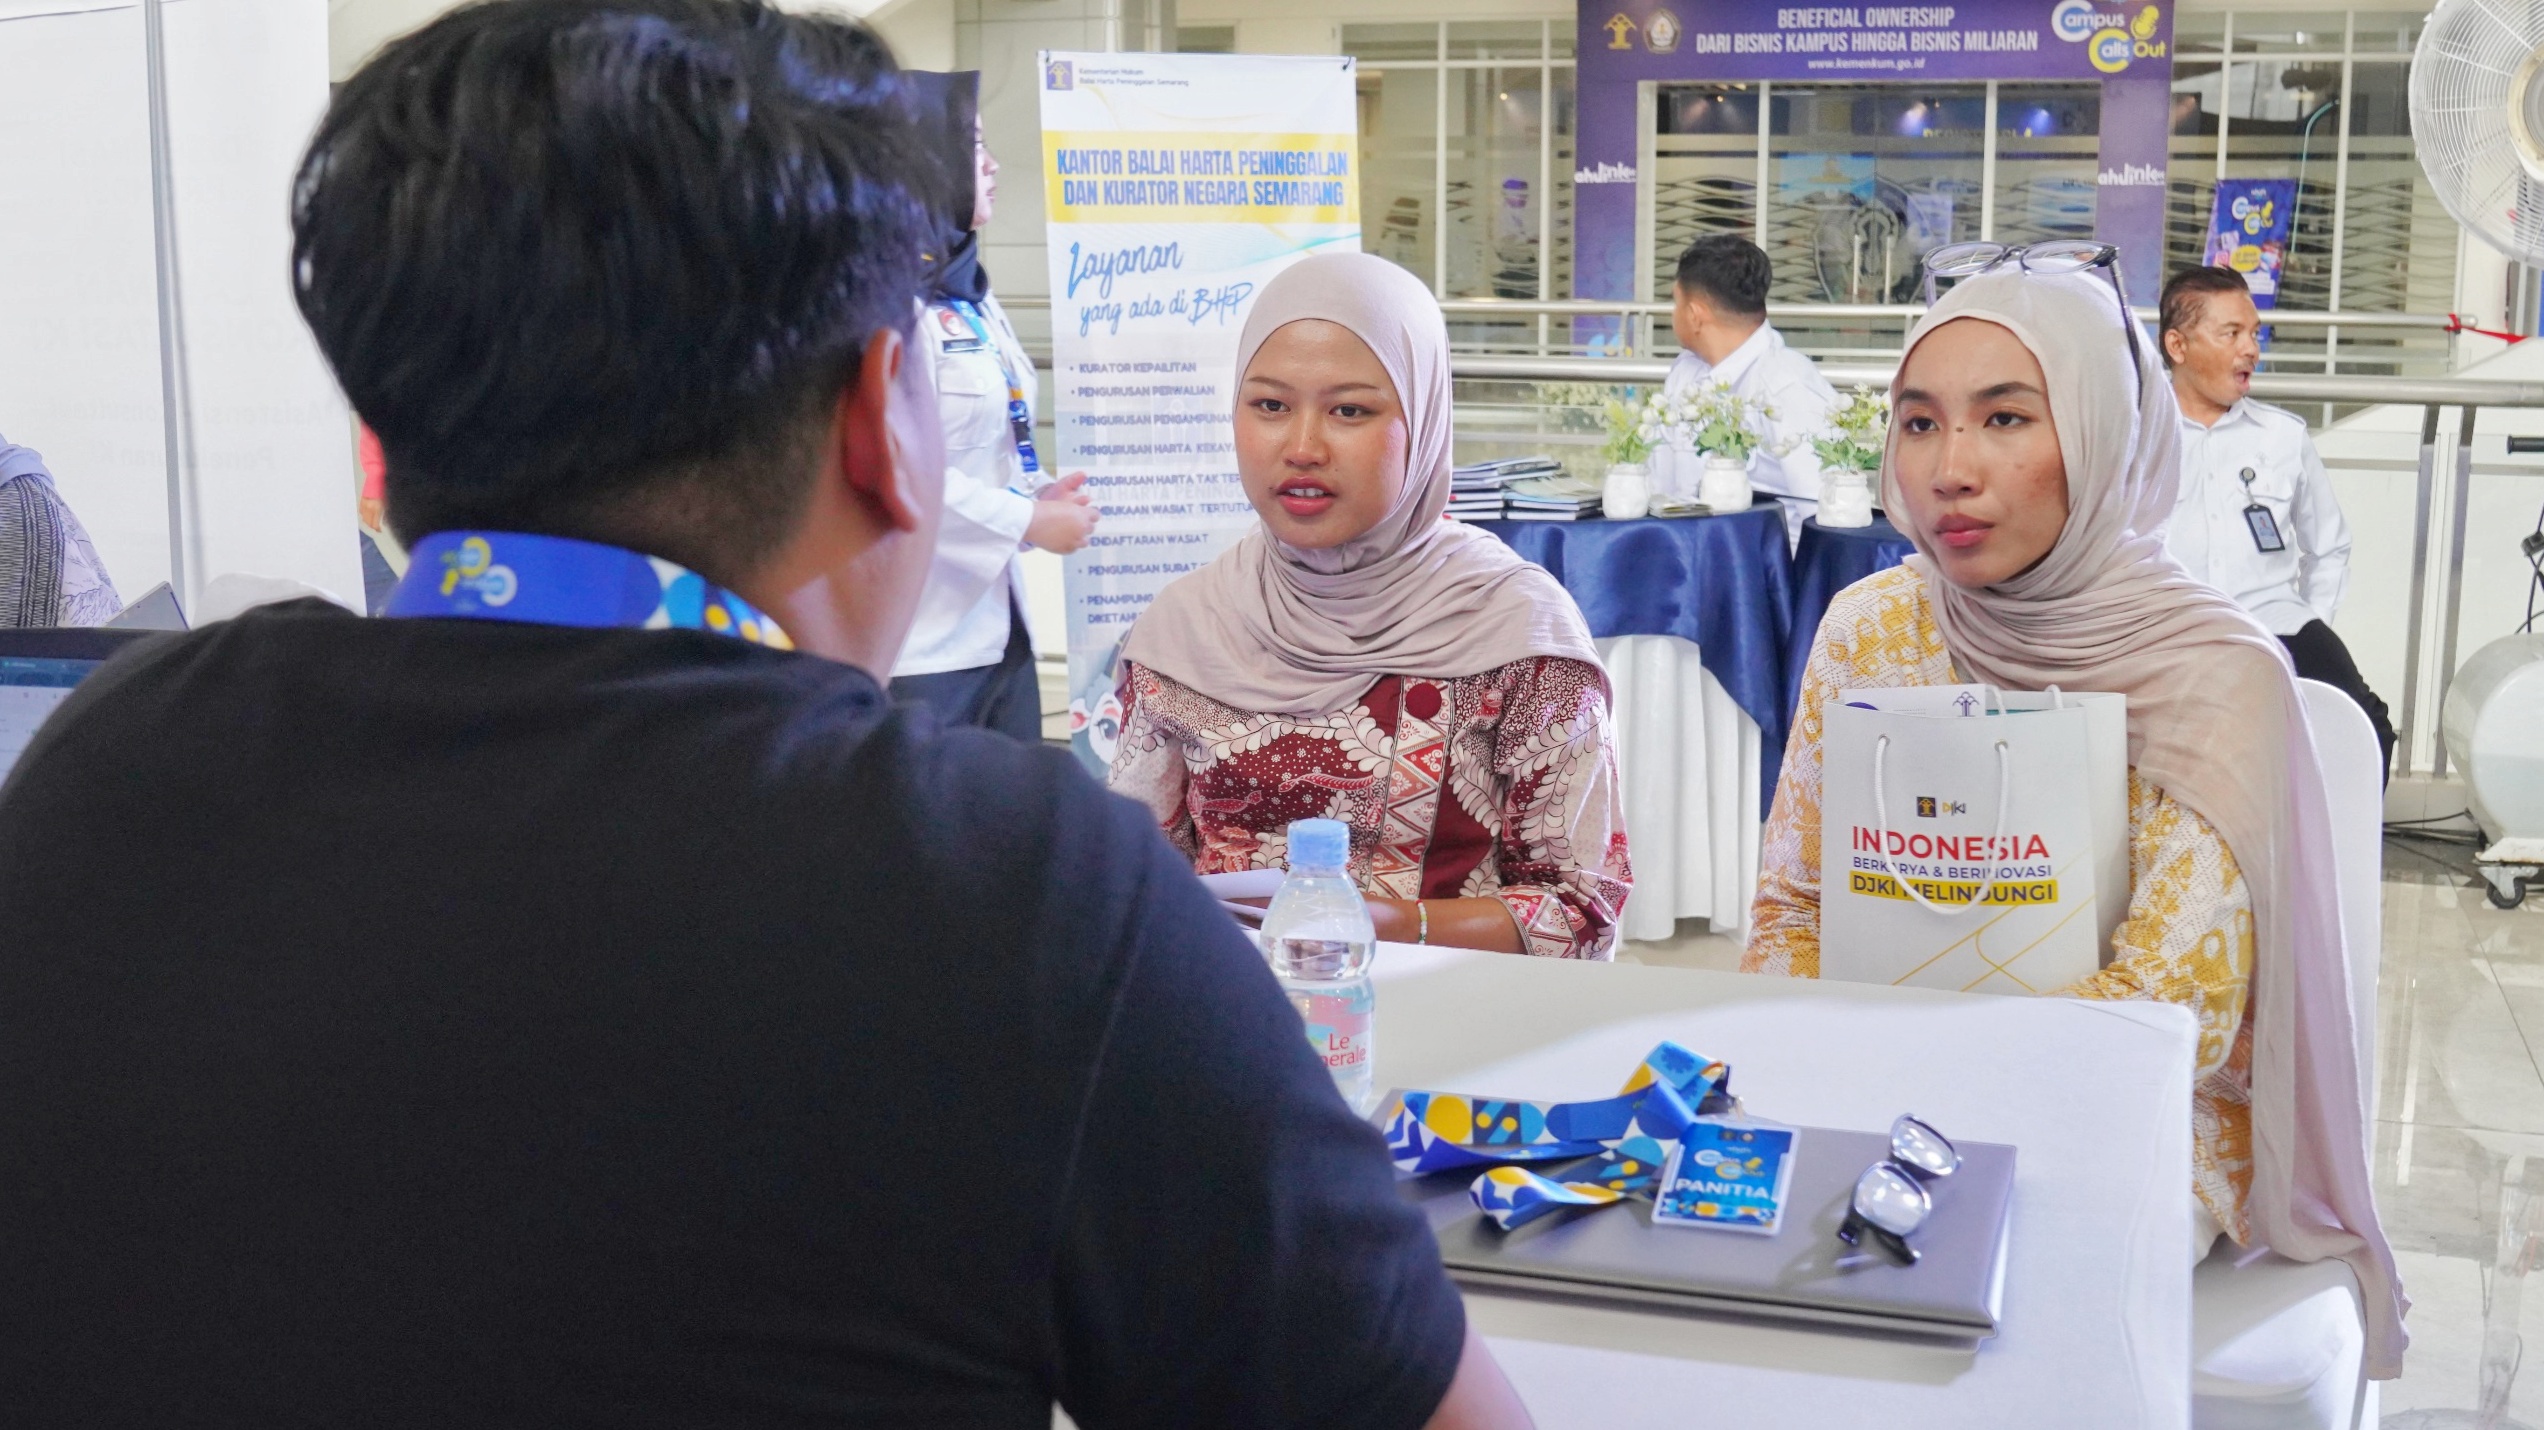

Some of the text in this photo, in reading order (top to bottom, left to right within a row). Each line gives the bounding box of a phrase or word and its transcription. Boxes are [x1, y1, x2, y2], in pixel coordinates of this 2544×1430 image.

[1777, 6, 1955, 29] BENEFICIAL OWNERSHIP
[1696, 30, 2038, 54] DARI BISNIS KAMPUS HINGGA BISNIS MILIARAN
[2133, 40, 2167, 58] Out
[1807, 57, 1926, 71] www.kemenkum.go.id
[1057, 149, 1348, 176] KANTOR BALAI HARTA PENINGGALAN
[1064, 180, 1344, 206] DAN KURATOR NEGARA SEMARANG
[1068, 241, 1183, 299] Layanan
[1080, 282, 1253, 337] yang ada di BHP
[1079, 362, 1197, 374] KURATOR KEPAILITAN
[1078, 385, 1216, 397] PENGURUSAN PERWALIAN
[1079, 414, 1150, 426] PENGURUSAN
[1080, 444, 1152, 456] PENGURUSAN
[1154, 443, 1192, 454] HARTA
[1156, 474, 1194, 486] HARTA
[1196, 473, 1219, 484] TAK
[1151, 503, 1194, 515] WASIAT
[1199, 502, 1254, 513] TERTUTU
[1089, 533, 1209, 547] ENDAFTARAN WASIAT
[1088, 564, 1160, 576] PENGURUSAN
[1162, 562, 1198, 573] SURAT
[1852, 826, 2051, 862] INDONESIA
[1932, 866, 1944, 878] &
[1853, 874, 1896, 896] DJKI
[1329, 1032, 1351, 1051] Le
[1321, 1045, 1367, 1068] nerale
[1675, 1178, 1770, 1199] PANITIA
